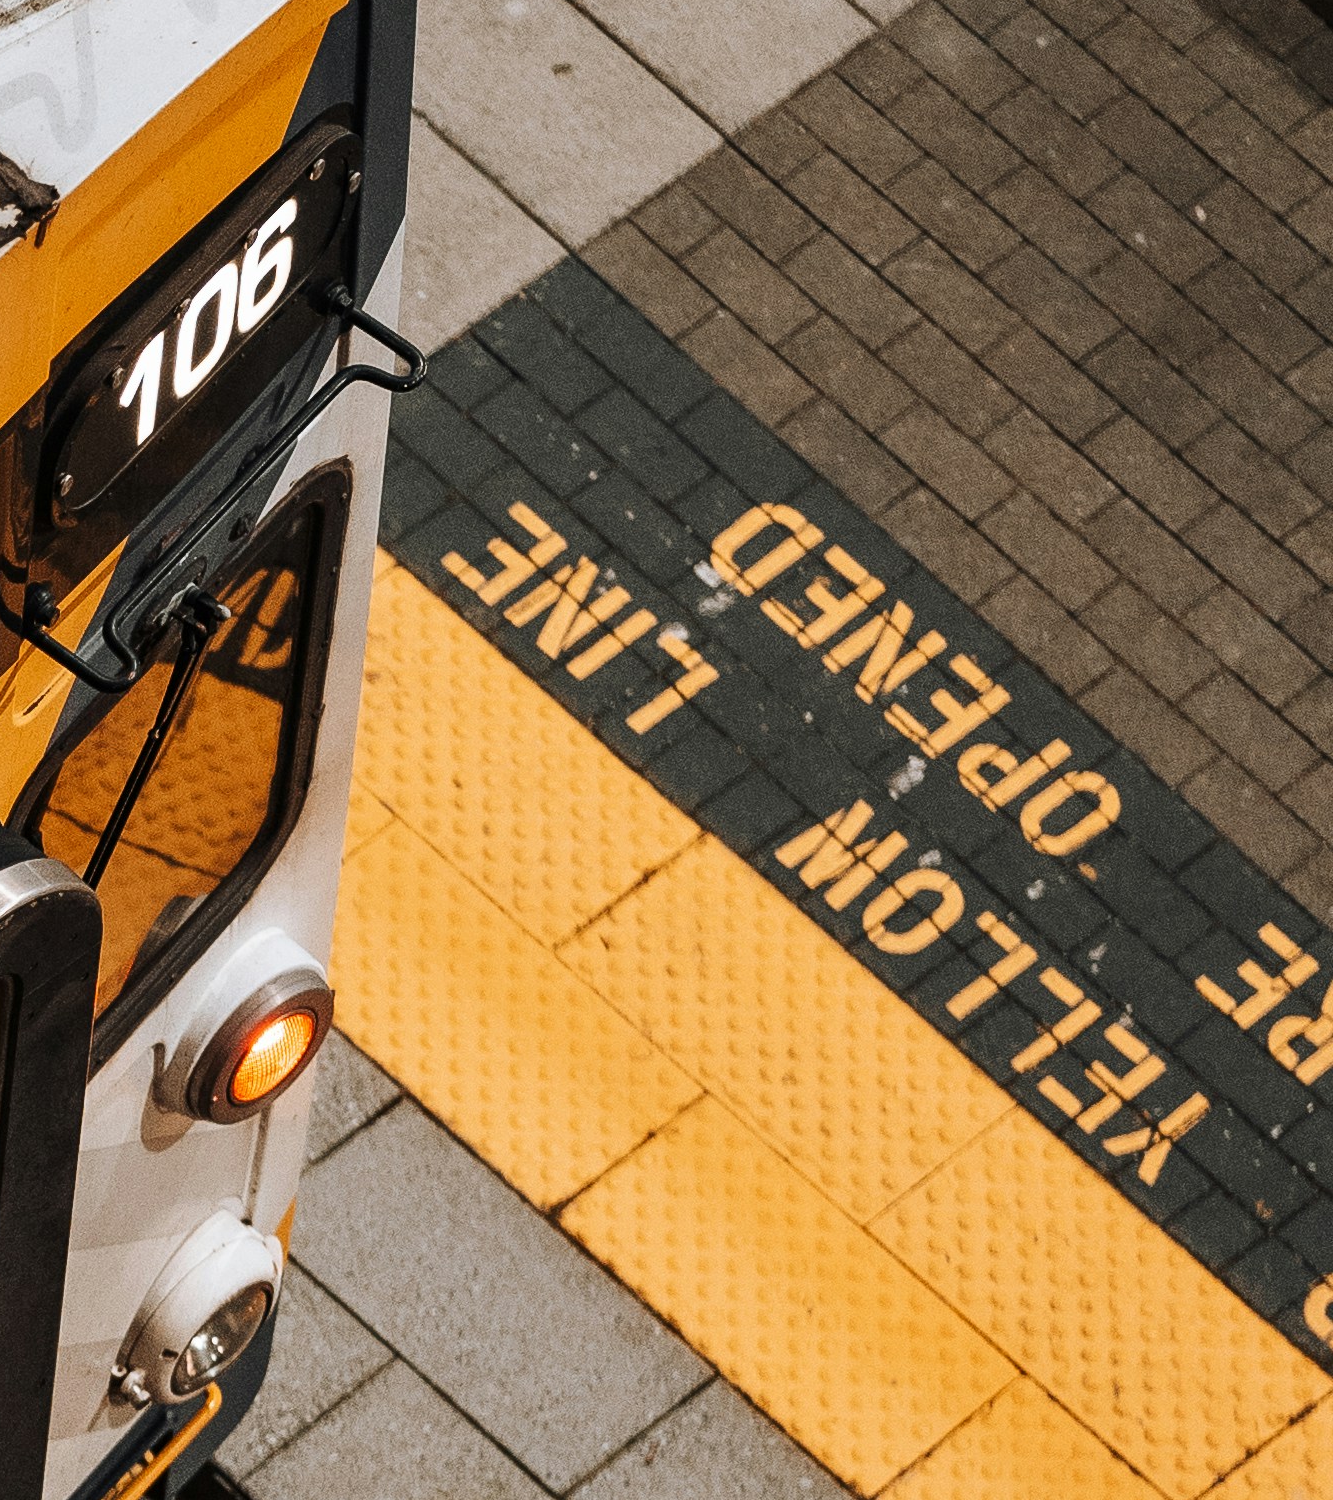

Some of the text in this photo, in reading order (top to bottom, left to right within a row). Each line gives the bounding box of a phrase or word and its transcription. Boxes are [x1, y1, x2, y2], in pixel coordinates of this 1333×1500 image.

[118, 198, 298, 446] 106
[440, 501, 1211, 1187] YELLOW LINE
[709, 502, 1122, 856] OPENED
